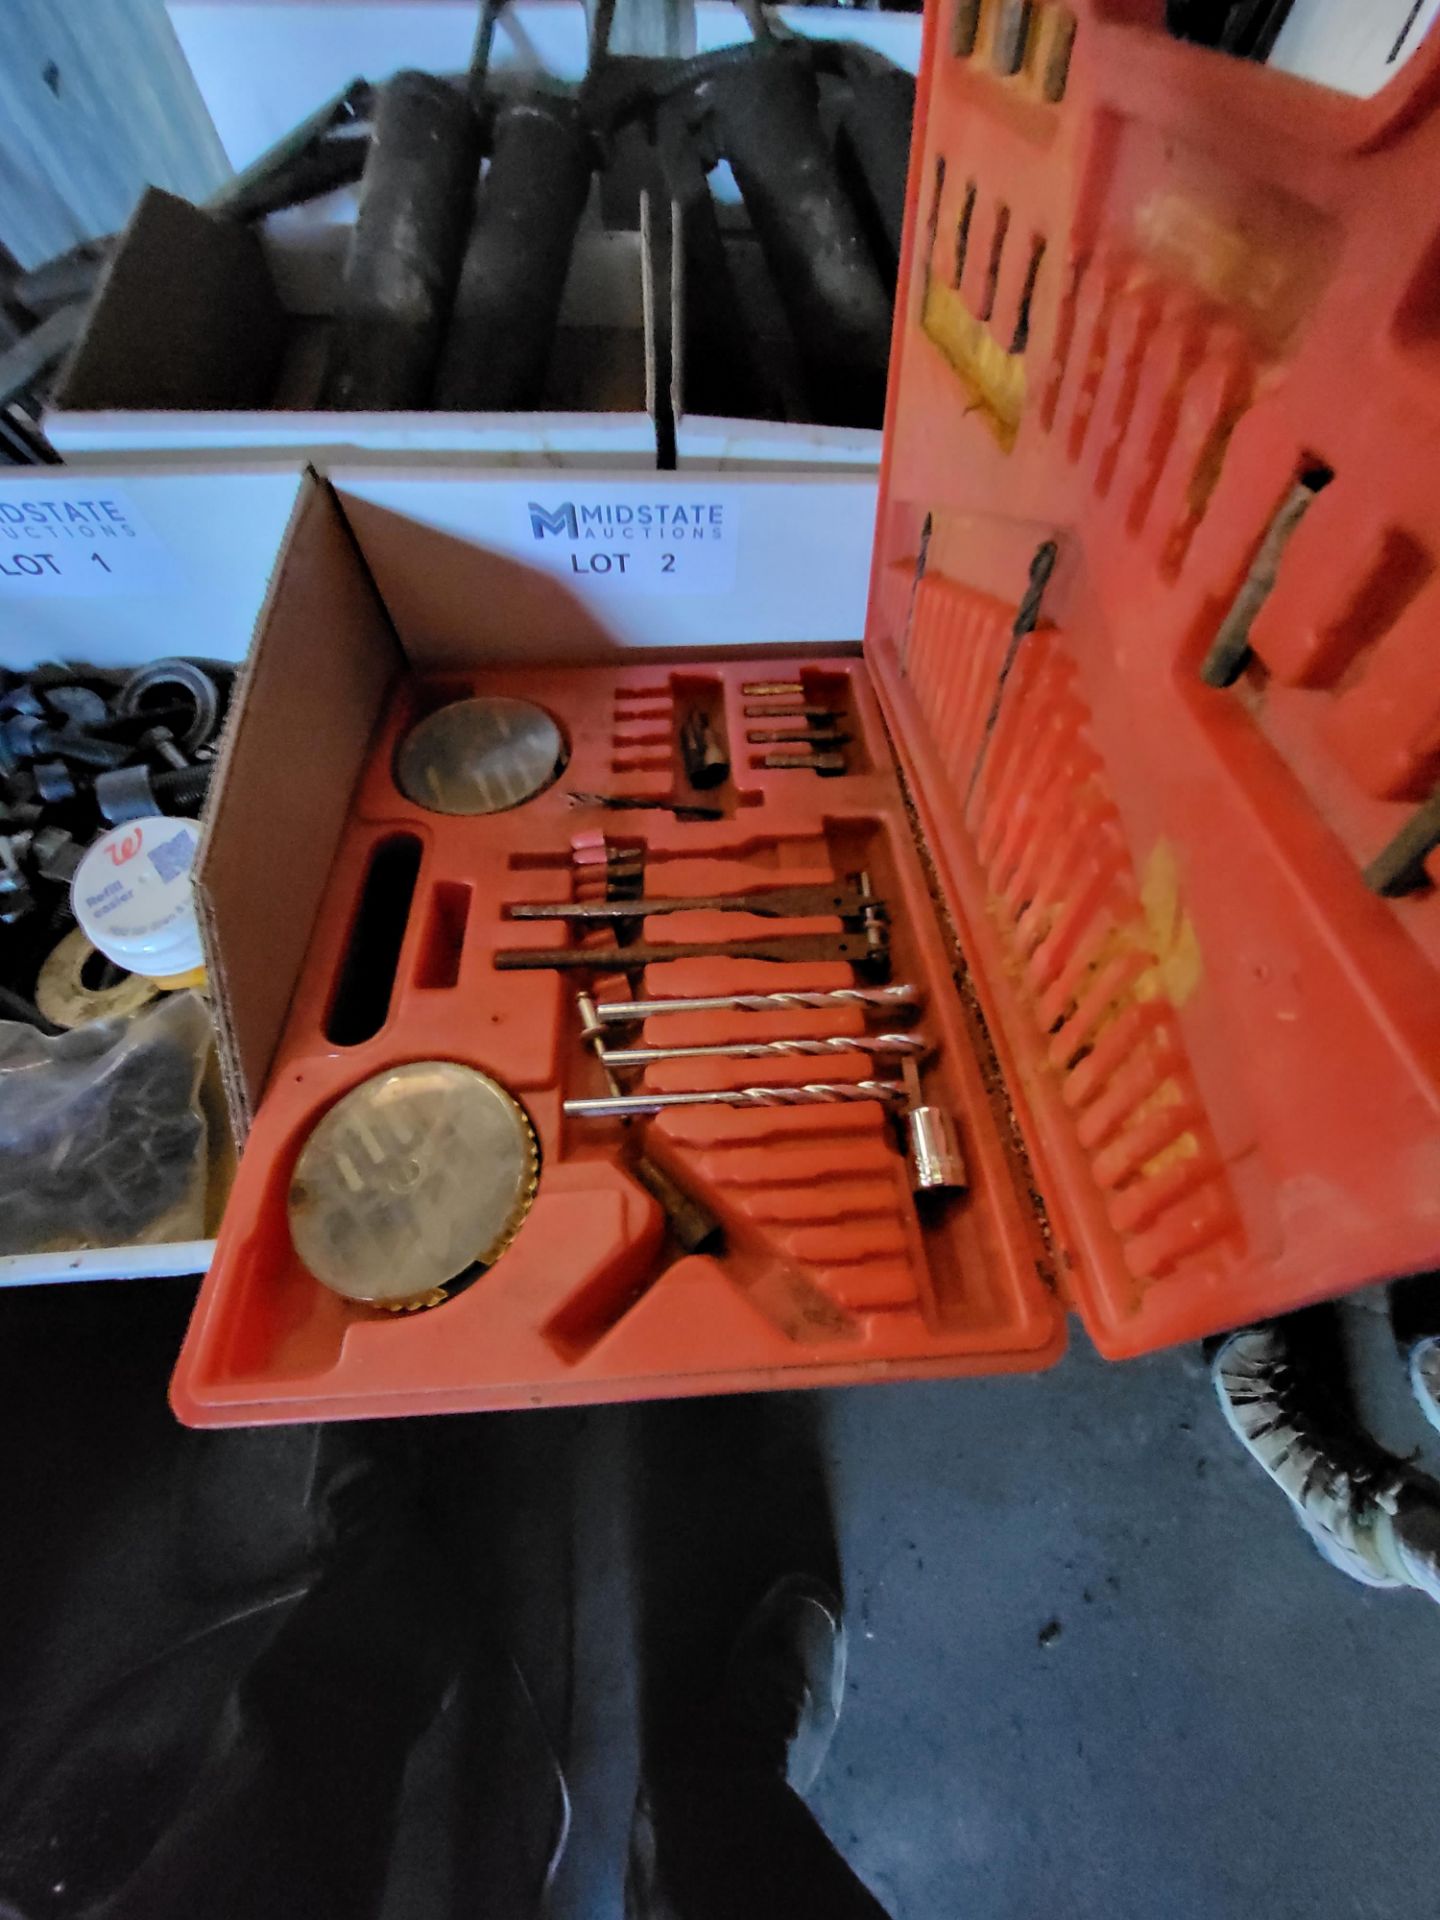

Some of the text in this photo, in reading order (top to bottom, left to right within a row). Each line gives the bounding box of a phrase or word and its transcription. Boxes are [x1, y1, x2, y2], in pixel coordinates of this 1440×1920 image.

[580, 504, 724, 525] MIDSTATE
[584, 526, 723, 540] AUCTIONS
[91, 552, 112, 574] 1
[571, 553, 676, 574] LOT 2
